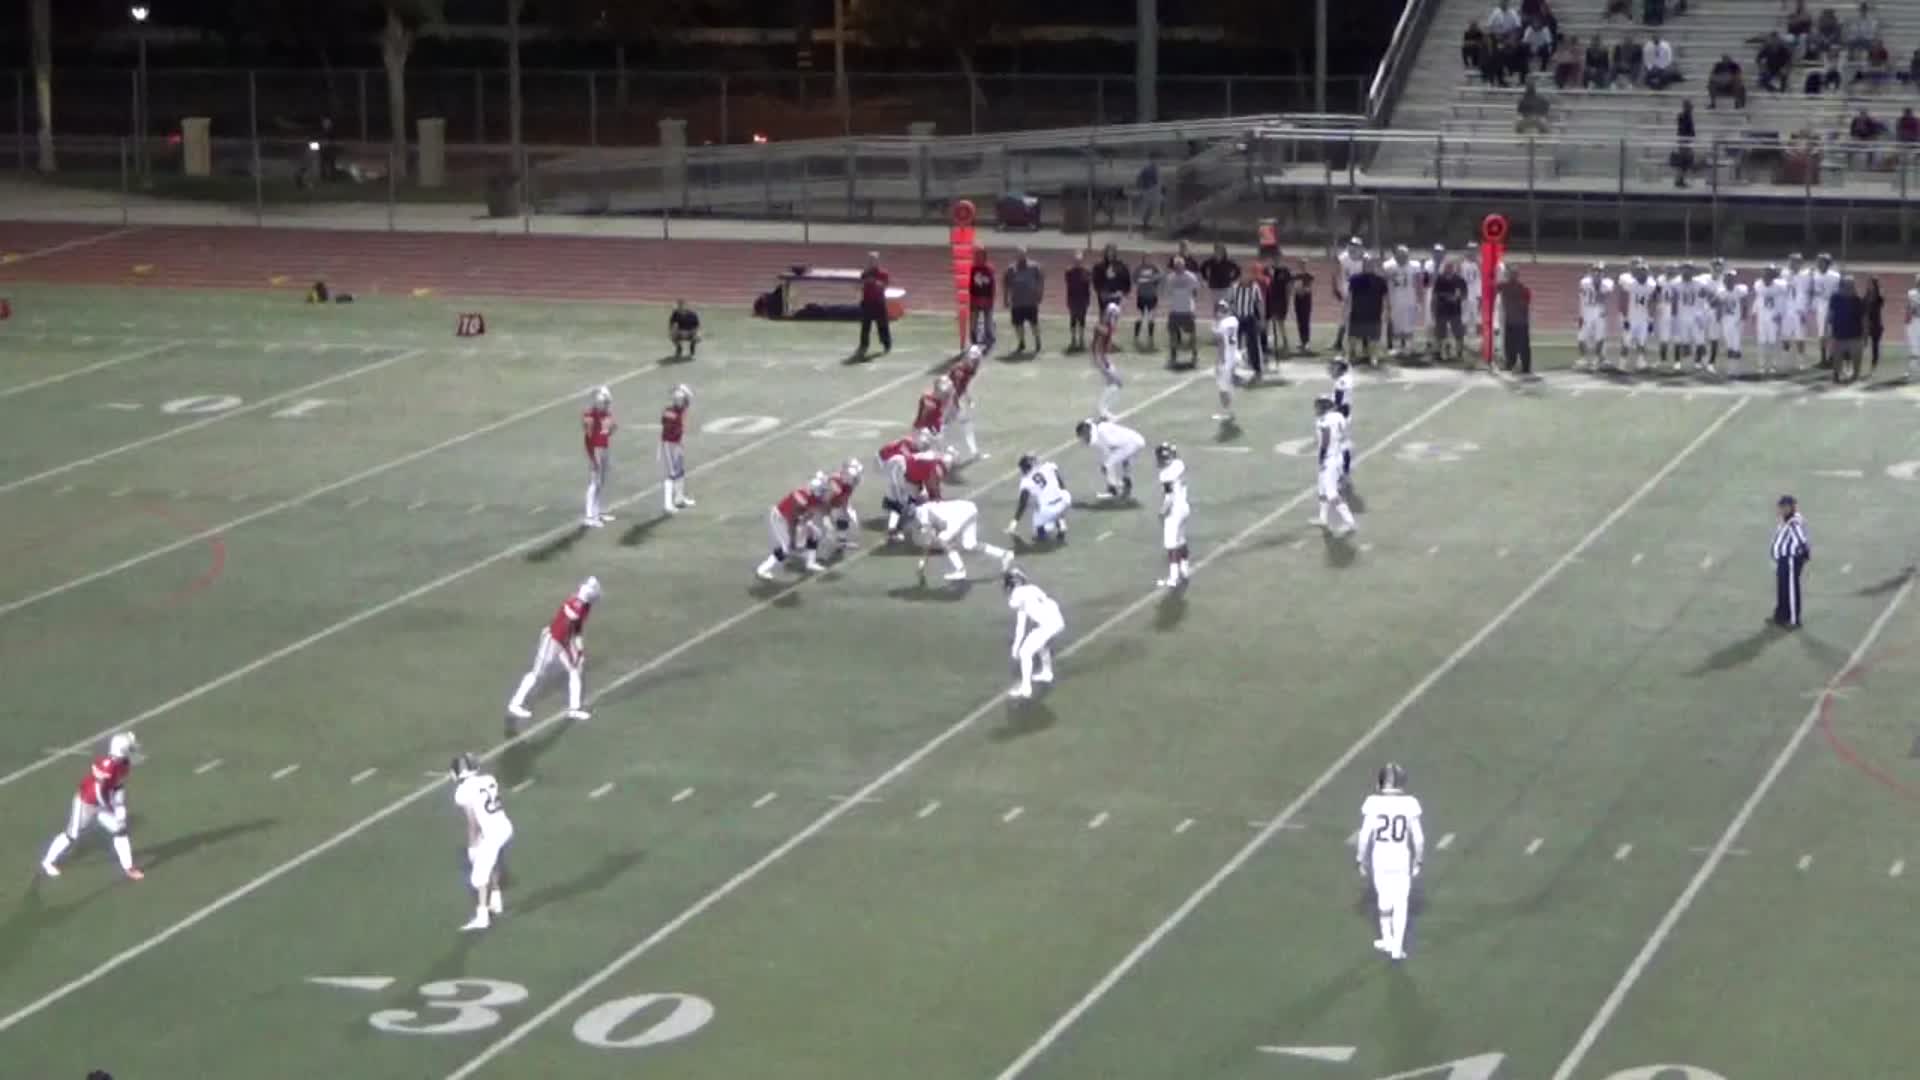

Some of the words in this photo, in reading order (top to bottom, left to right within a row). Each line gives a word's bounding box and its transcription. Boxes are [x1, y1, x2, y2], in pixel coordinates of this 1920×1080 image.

[1031, 471, 1048, 489] 9
[1374, 812, 1408, 843] 20
[366, 977, 716, 1048] 30
